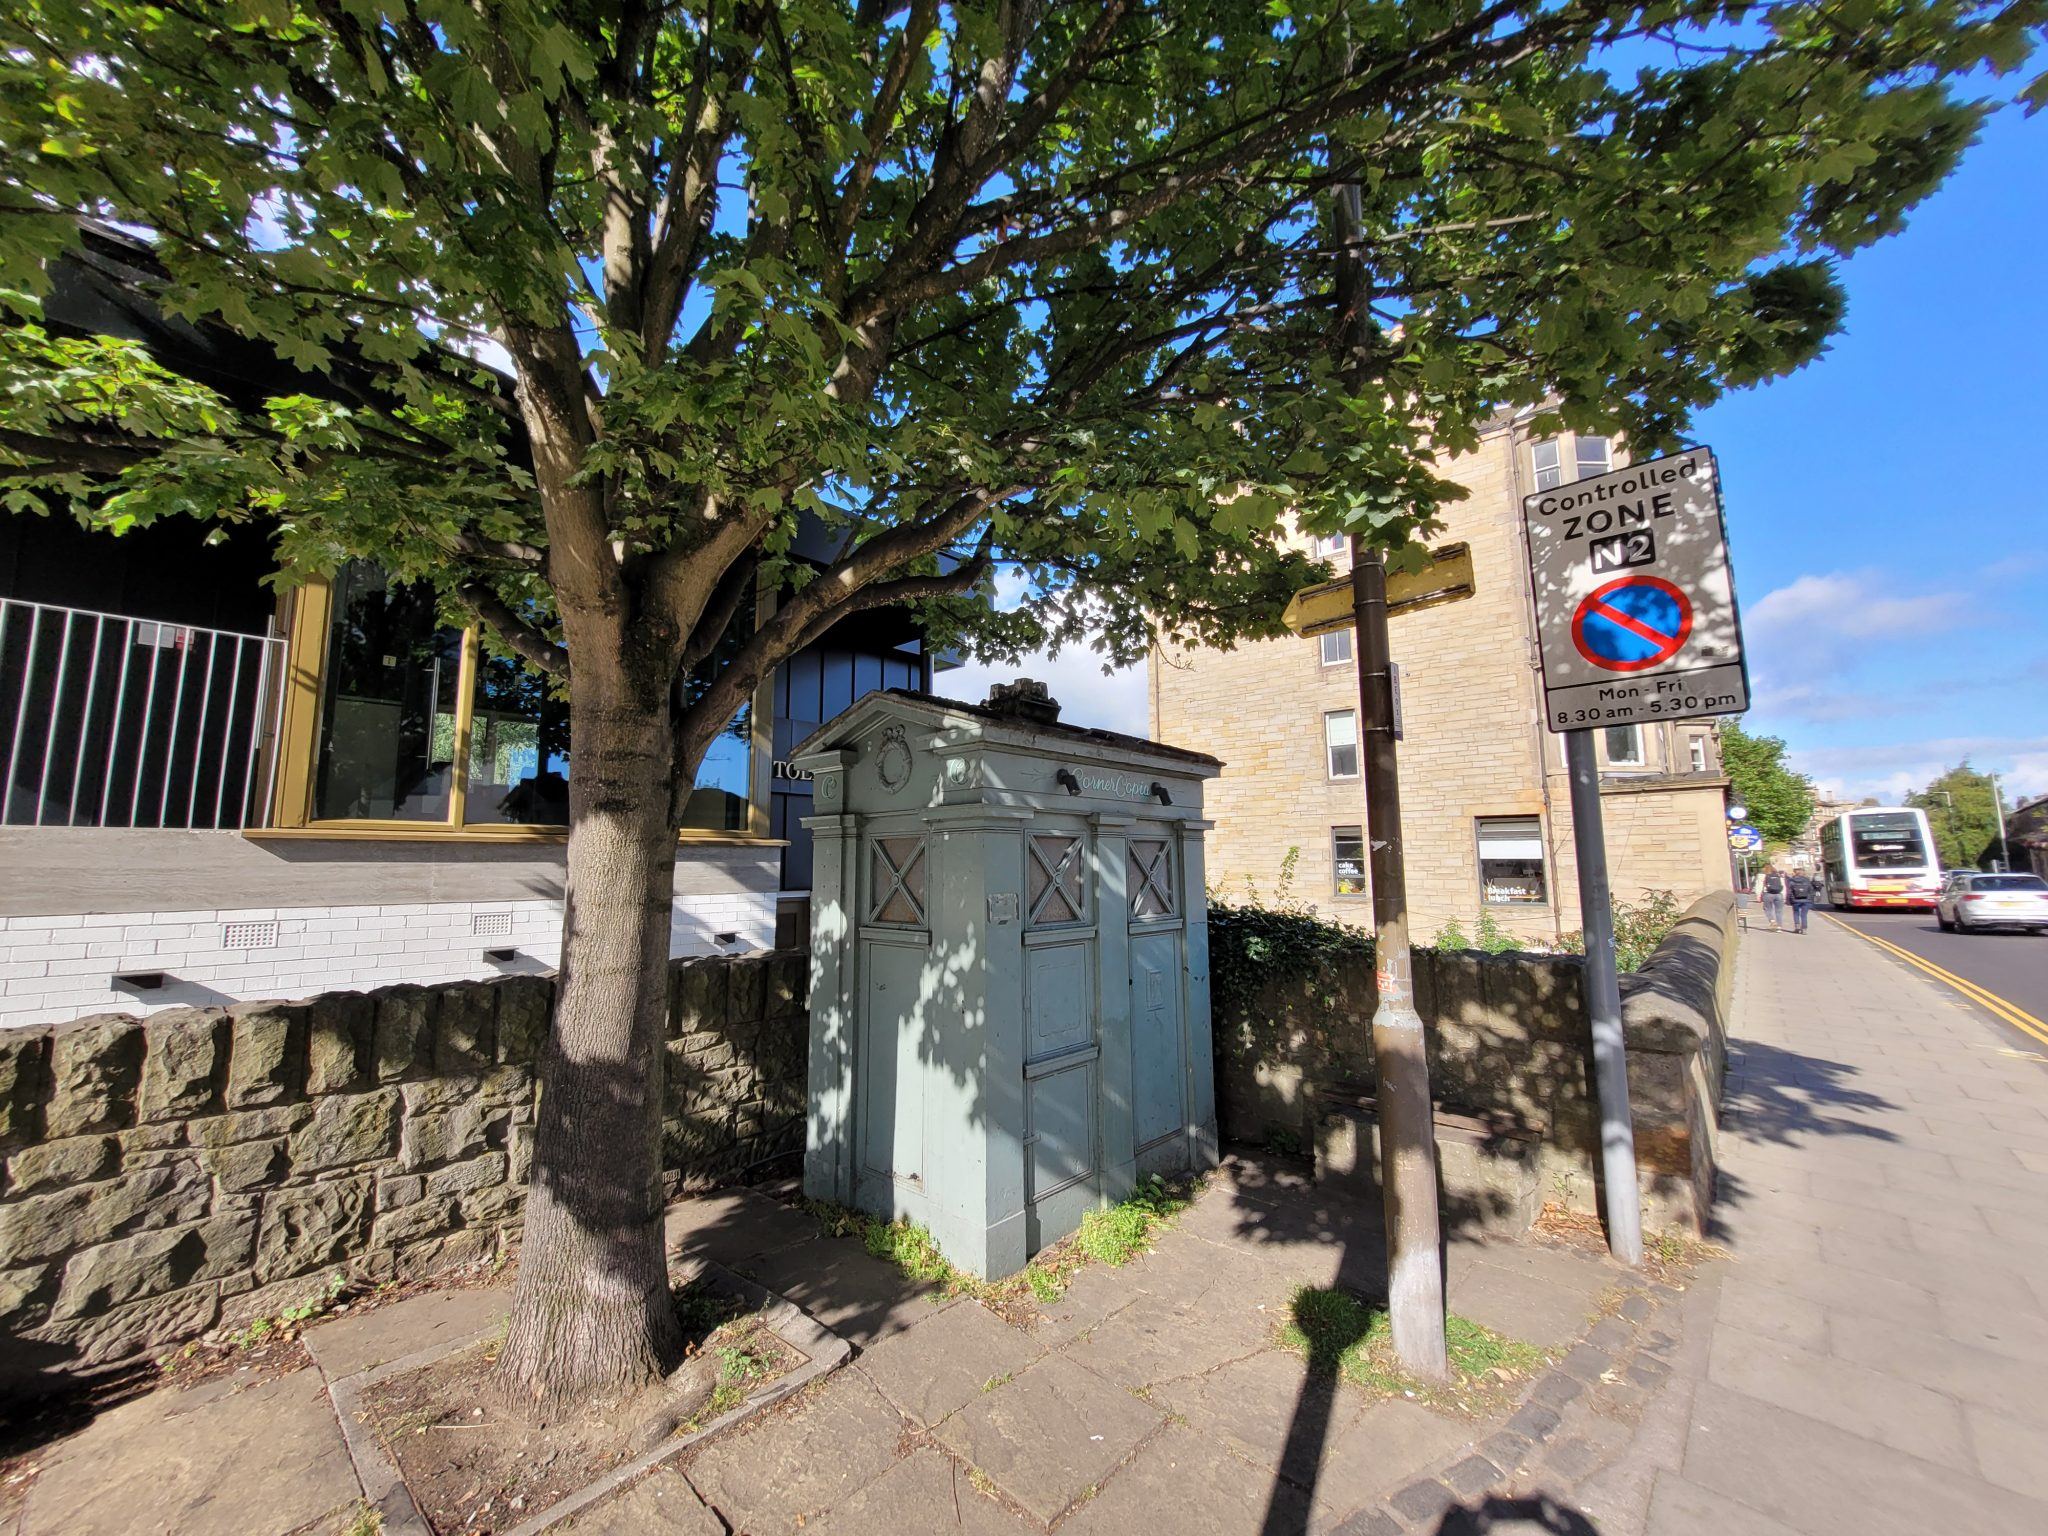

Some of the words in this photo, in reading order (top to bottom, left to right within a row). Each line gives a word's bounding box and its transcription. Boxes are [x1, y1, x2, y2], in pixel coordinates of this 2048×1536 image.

[1538, 457, 1697, 516] Controlled
[1562, 492, 1675, 541] ZONE
[1594, 534, 1652, 570] N2
[1599, 687, 1639, 701] Mon
[1656, 679, 1683, 694] Fri
[1557, 707, 1601, 724] 8.30
[1606, 706, 1633, 719] am
[1650, 696, 1698, 713] 5.30
[1705, 694, 1737, 710] pm
[1338, 861, 1354, 869] cake
